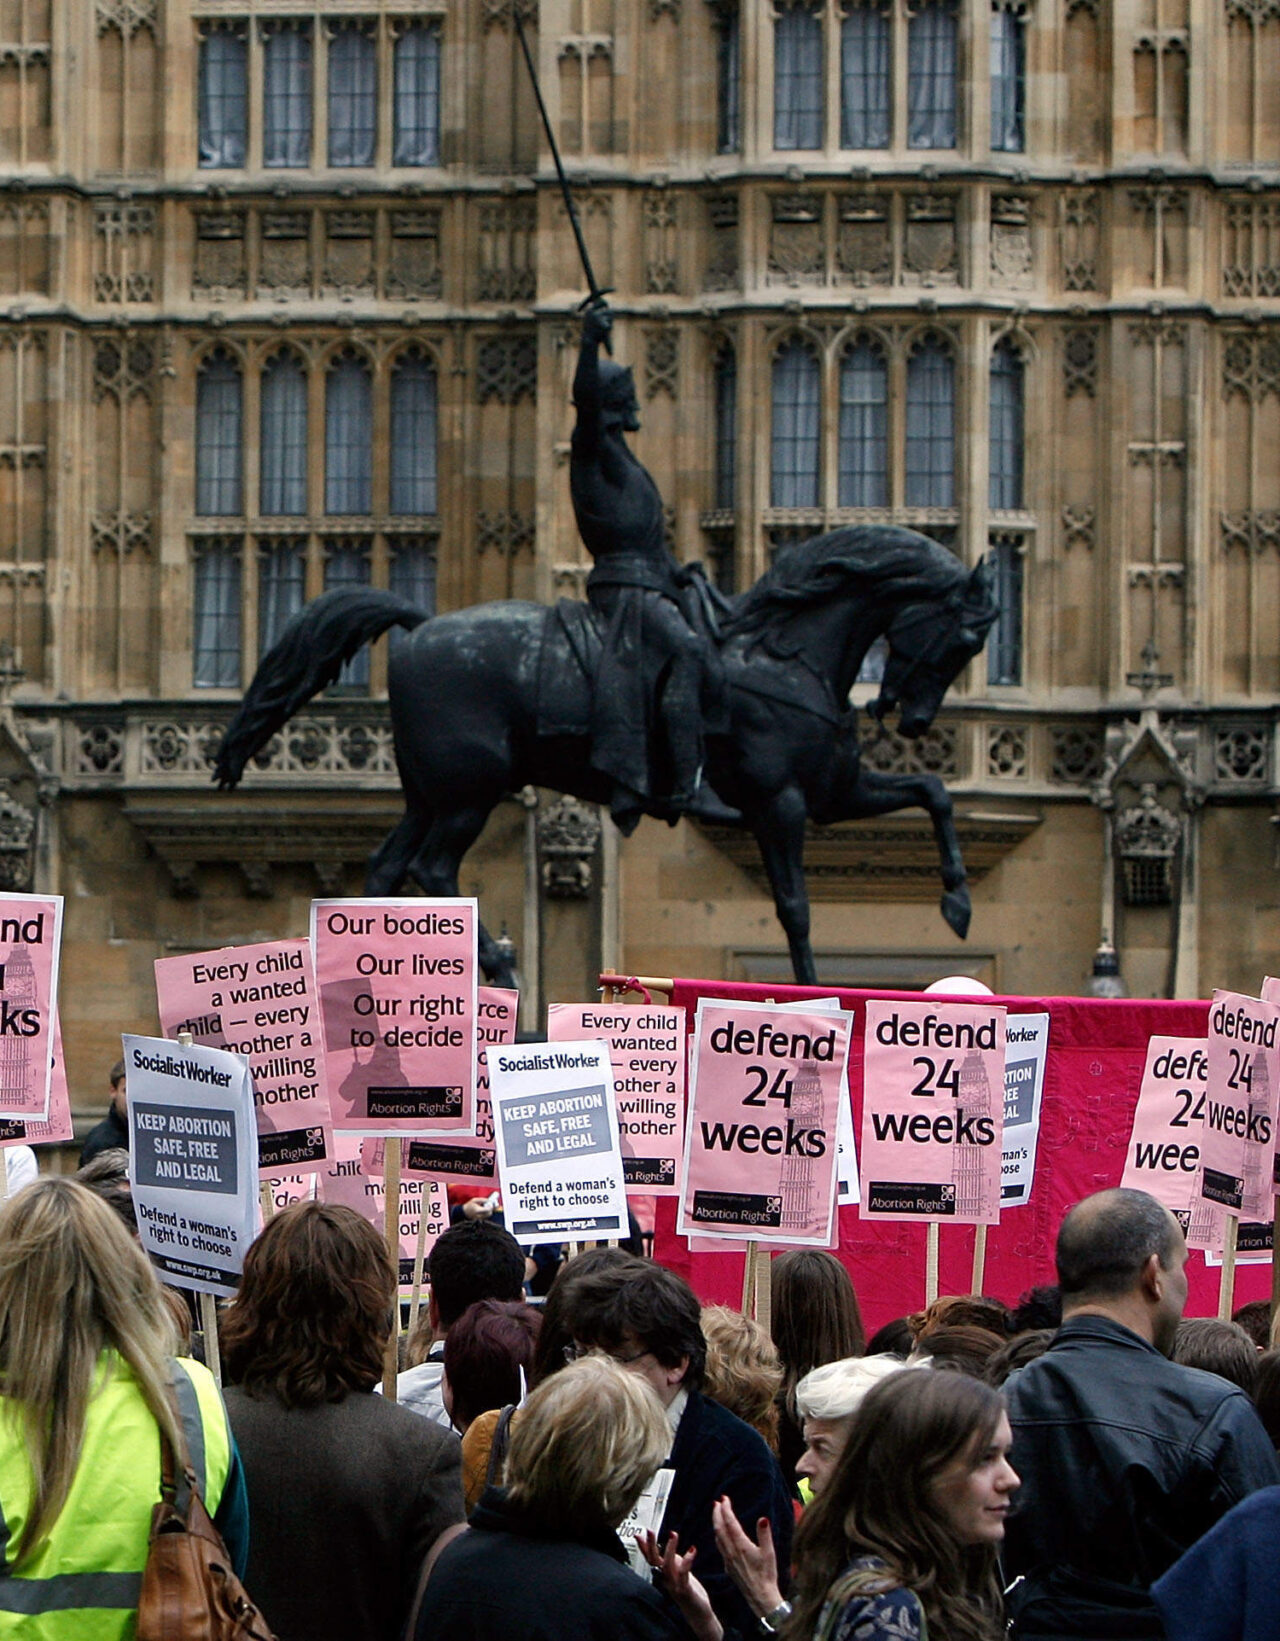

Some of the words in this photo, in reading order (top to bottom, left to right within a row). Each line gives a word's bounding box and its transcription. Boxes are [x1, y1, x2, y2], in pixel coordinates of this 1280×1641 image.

[327, 912, 376, 935] Our
[383, 912, 465, 935] bodies
[192, 963, 249, 985] Every
[255, 950, 304, 976] child
[355, 953, 404, 976] Our
[412, 953, 465, 976] lives
[211, 992, 223, 1008] a
[229, 976, 307, 1005] wanted
[353, 994, 401, 1017] Our
[408, 993, 465, 1021] right
[176, 1014, 222, 1037] child
[254, 1005, 310, 1029] every
[581, 1012, 631, 1032] Every
[636, 1013, 677, 1031] child
[876, 1013, 997, 1050] defend
[1213, 1003, 1278, 1048] defend
[300, 1033, 312, 1048] a
[350, 1028, 374, 1047] to
[383, 1026, 464, 1048] decide
[612, 1036, 677, 1052] wanted
[710, 1020, 837, 1062] defend
[250, 1056, 317, 1083] willing
[628, 1059, 678, 1076] every
[911, 1056, 960, 1098] 24
[1152, 1048, 1208, 1081] defe
[1227, 1048, 1253, 1093] 24
[613, 1077, 662, 1093] other
[665, 1080, 676, 1093] a
[742, 1065, 795, 1108] 24
[1003, 1090, 1019, 1101] REE
[370, 1101, 414, 1114] Abortion
[417, 1101, 451, 1117] Rights
[503, 1104, 537, 1123] KEEP
[539, 1092, 604, 1115] ABORTION
[619, 1098, 677, 1118] willing
[136, 1112, 166, 1131] KEEP
[168, 1117, 232, 1138] ABORTION
[523, 1119, 560, 1138] SAFE,
[561, 1113, 593, 1131] FREE
[872, 1107, 996, 1146] weeks
[1208, 1100, 1272, 1145] weeks
[154, 1138, 187, 1158] SAFE,
[187, 1141, 220, 1161] FREE
[526, 1139, 555, 1157] AND
[555, 1132, 597, 1151] LEGAL
[700, 1118, 827, 1158] weeks
[279, 1146, 315, 1163] Rights
[411, 1157, 453, 1170] Abortion
[453, 1158, 485, 1174] Rights
[1001, 1147, 1028, 1161] man's
[1134, 1142, 1200, 1172] wee
[155, 1160, 183, 1178] AND
[183, 1164, 223, 1183] LEGAL
[635, 1170, 665, 1184] Rights
[509, 1179, 553, 1196] Defend
[556, 1182, 564, 1193] a
[565, 1176, 616, 1192] woman's
[519, 1194, 552, 1211] right
[553, 1195, 566, 1207] to
[568, 1192, 610, 1207] choose
[871, 1197, 914, 1210] Abortion
[916, 1198, 947, 1213] Rights
[139, 1203, 177, 1229] Defend
[179, 1218, 188, 1230] a
[188, 1219, 238, 1243] woman's
[695, 1206, 738, 1220] Abortion
[740, 1208, 771, 1223] Rights
[149, 1225, 177, 1248] right
[177, 1231, 190, 1246] to
[191, 1234, 233, 1257] choose
